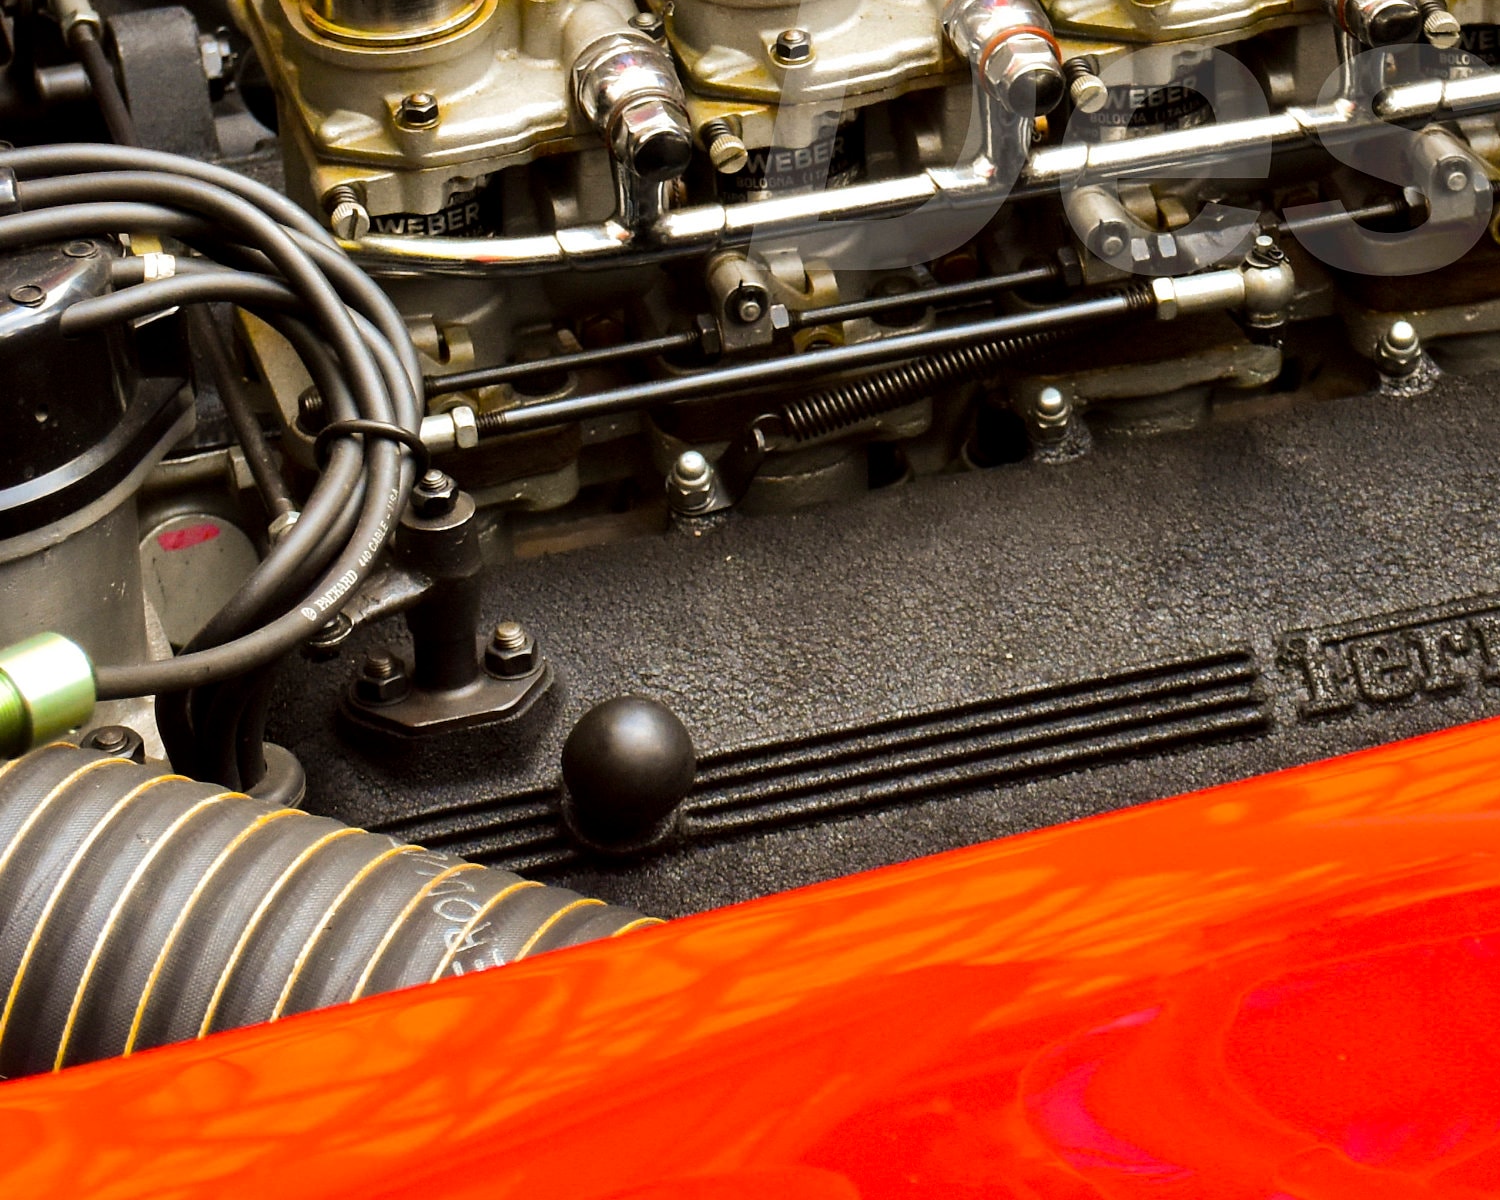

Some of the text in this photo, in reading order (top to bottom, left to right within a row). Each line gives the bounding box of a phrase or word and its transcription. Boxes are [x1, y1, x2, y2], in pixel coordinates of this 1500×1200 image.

[1104, 76, 1198, 111] WEBER
[746, 136, 845, 174] WEBER
[376, 201, 480, 237] WEBER
[314, 569, 359, 611] PACKARD
[358, 550, 372, 567] 440
[368, 520, 389, 552] CABLE
